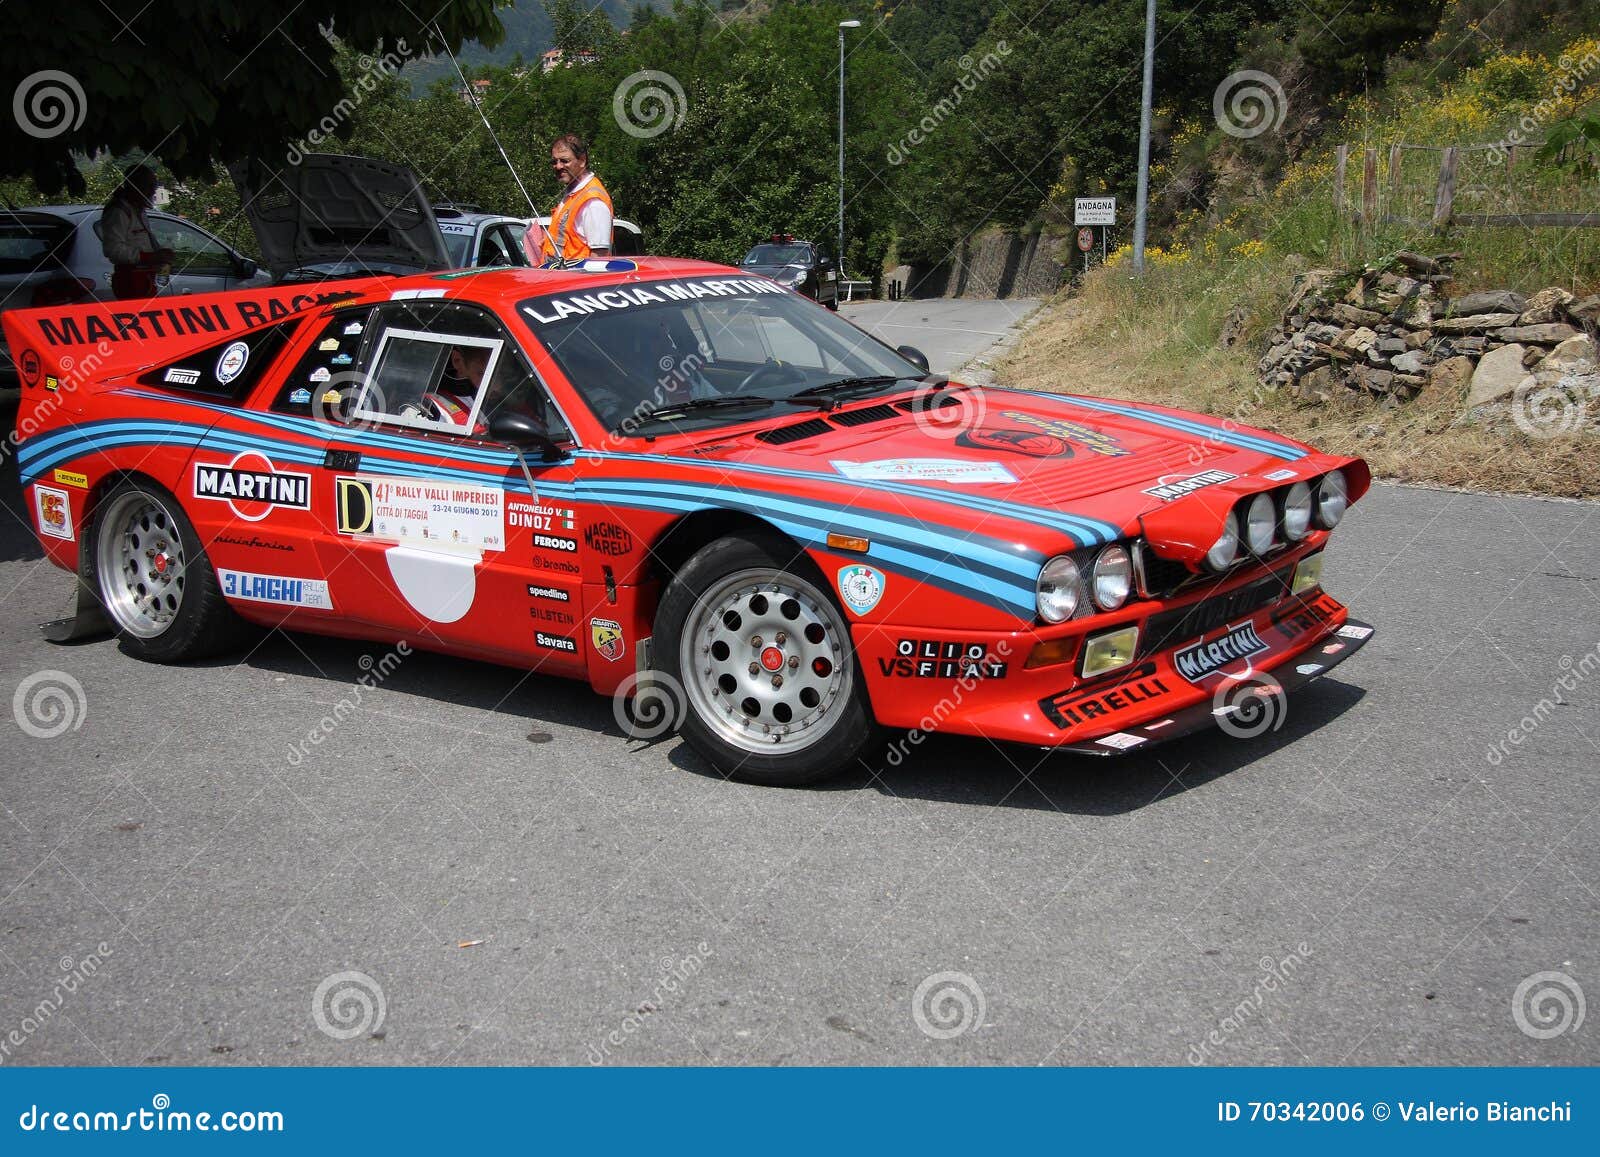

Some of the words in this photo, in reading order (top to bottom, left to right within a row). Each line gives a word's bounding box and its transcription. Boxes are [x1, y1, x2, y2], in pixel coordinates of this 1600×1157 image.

[1077, 202, 1112, 210] ANDAGNA
[523, 287, 659, 324] LANCIA
[655, 280, 789, 301] MARTINI
[38, 304, 231, 346] MARTINI
[236, 290, 366, 329] RAC
[165, 368, 201, 385] PIRELLI
[200, 470, 305, 504] MARTINI
[1150, 471, 1235, 498] MARTINI
[396, 485, 422, 499] RALLY
[425, 488, 449, 501] VALLI
[452, 490, 498, 506] IMPERIESI
[337, 479, 373, 534] D
[395, 507, 403, 519] DI
[404, 508, 429, 521] TAGGIA
[433, 504, 452, 513] 23-24
[453, 505, 479, 515] GIUGNO
[481, 508, 498, 518] 2012
[508, 502, 554, 517] ANTONELLO
[534, 535, 576, 551] FERODO
[543, 557, 580, 574] brembo
[225, 573, 237, 595] 3
[241, 575, 302, 602] LAGHI
[529, 586, 568, 601] speedline
[530, 607, 574, 625] BILSTEIN
[537, 633, 574, 651] Savara
[899, 640, 983, 659] OLIO
[1179, 627, 1261, 678] MARTINI
[878, 657, 915, 677] VS
[919, 662, 1003, 677] FIAT
[1038, 662, 1170, 730] PIRELLI
